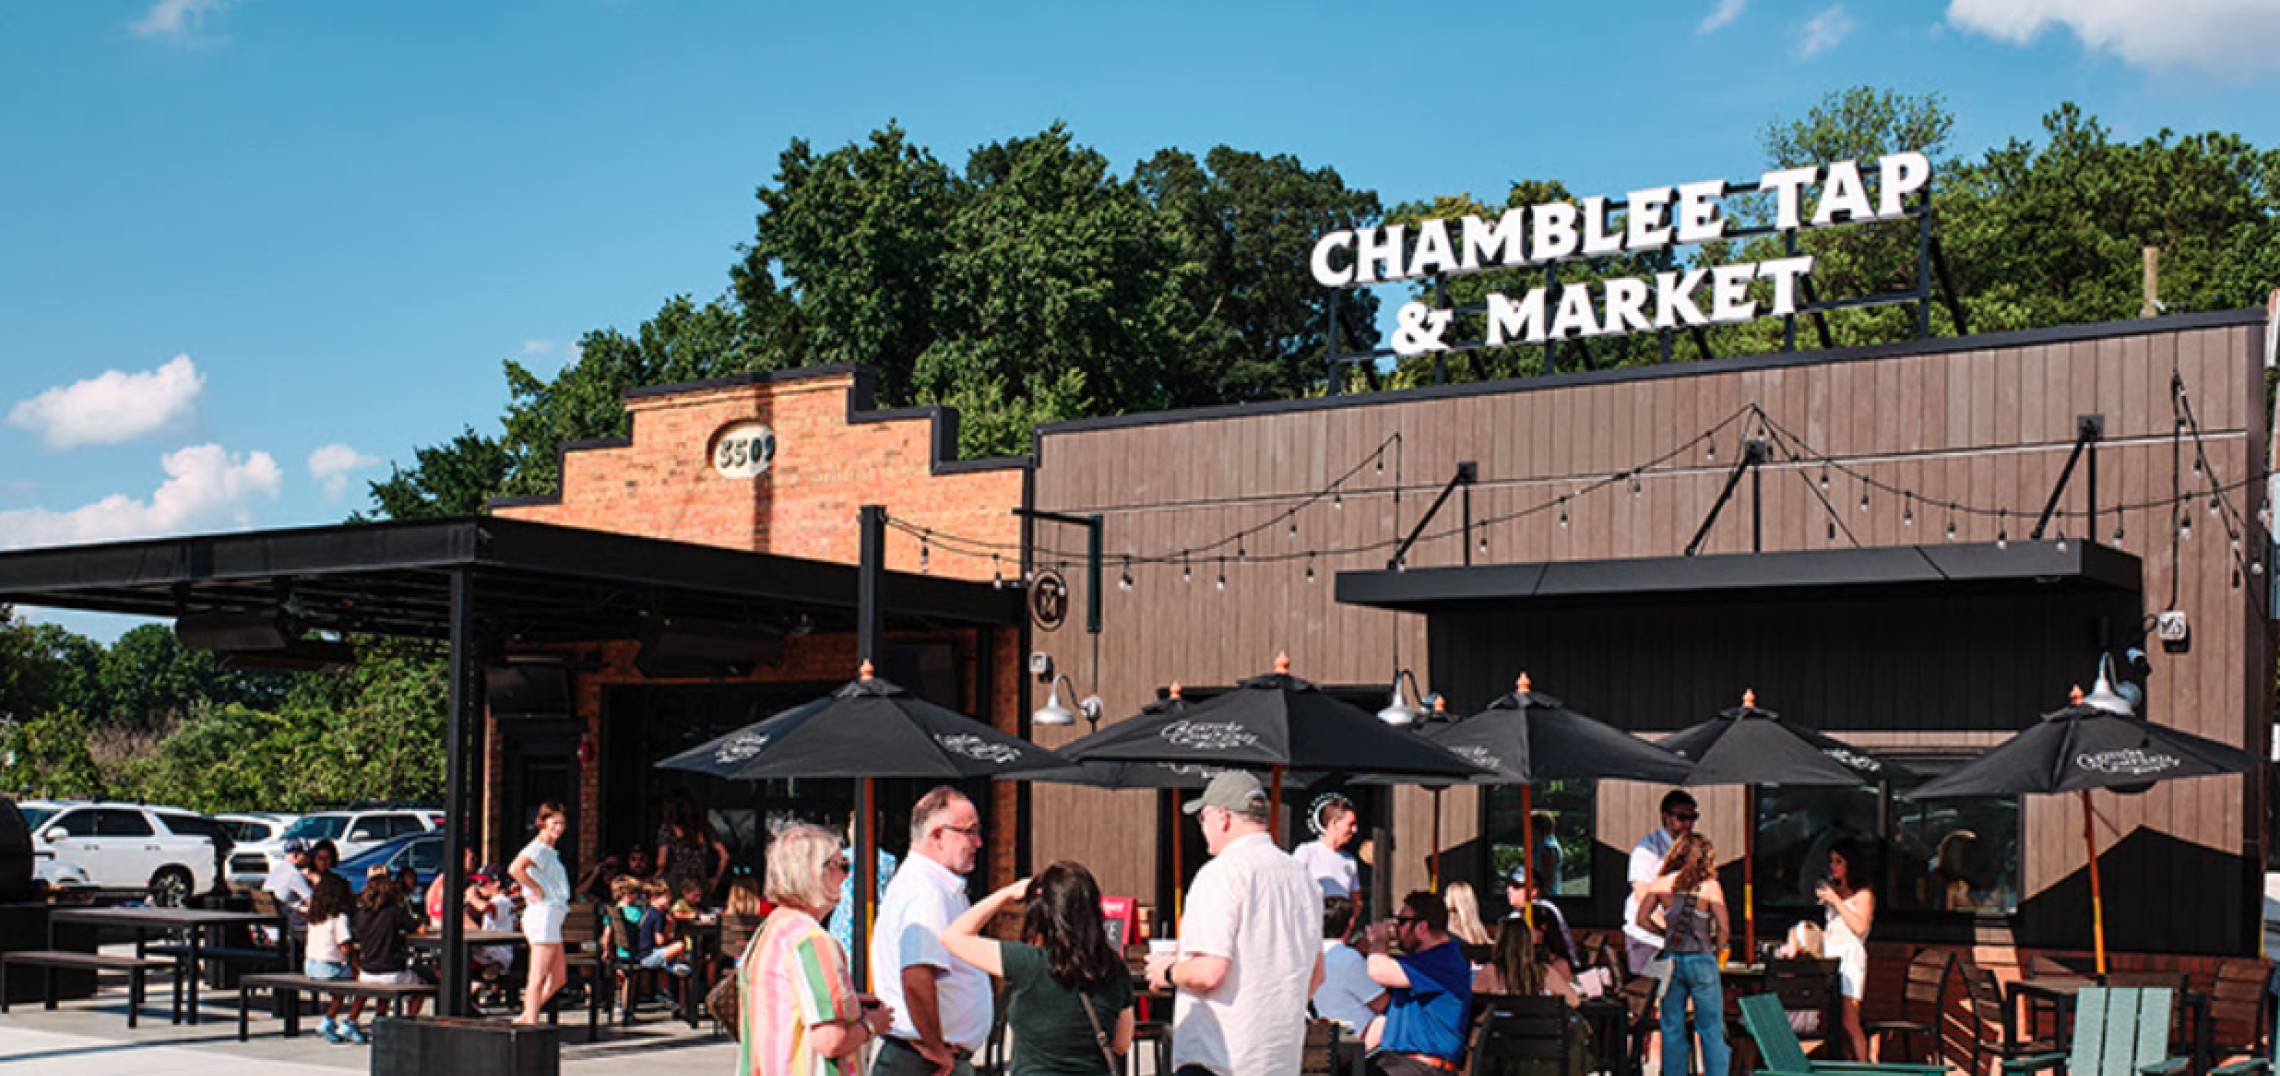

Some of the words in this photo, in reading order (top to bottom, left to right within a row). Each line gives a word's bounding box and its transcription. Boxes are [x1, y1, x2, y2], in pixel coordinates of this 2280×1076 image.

[1310, 179, 1727, 288] CHAMBLEE
[1760, 151, 1931, 231] TAP
[1392, 301, 1452, 355] &
[1486, 255, 1815, 345] MARKET
